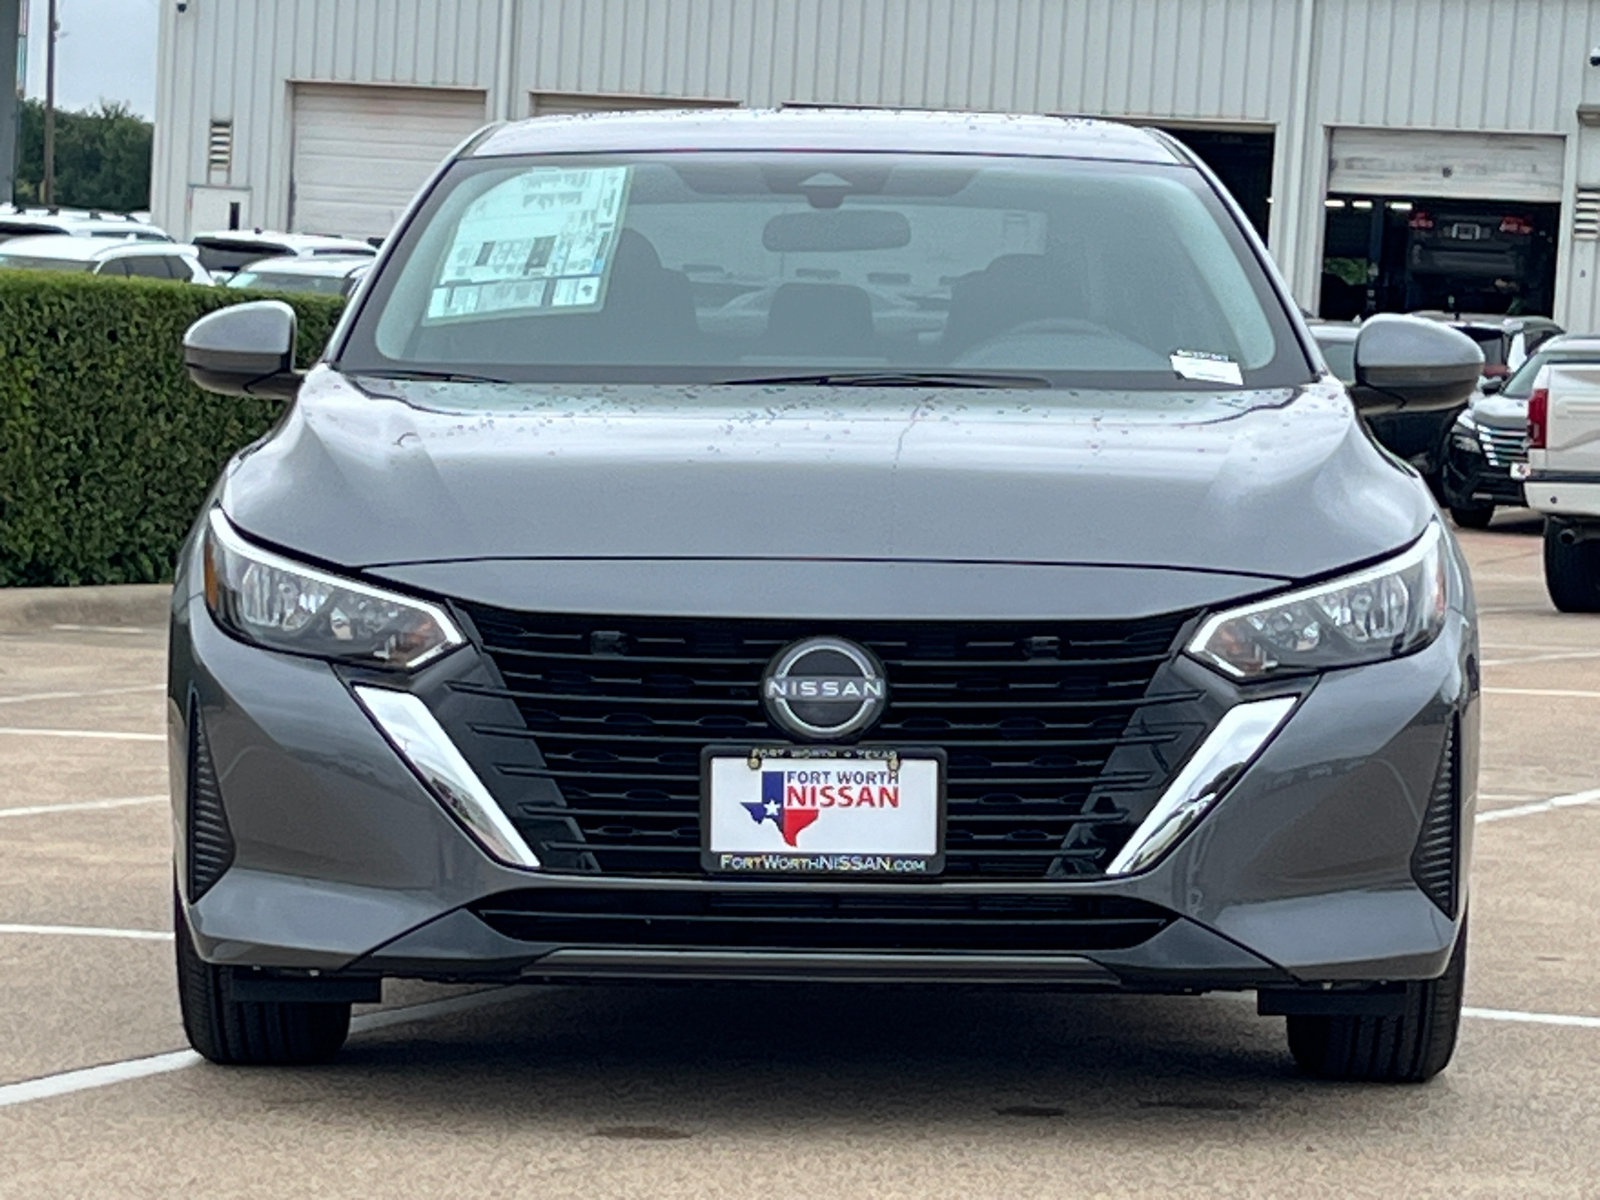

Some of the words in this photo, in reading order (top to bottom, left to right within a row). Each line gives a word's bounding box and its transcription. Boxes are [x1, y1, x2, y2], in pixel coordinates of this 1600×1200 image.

[768, 681, 882, 696] NISSAN
[786, 771, 831, 785] FORT
[836, 771, 900, 785] WORTH
[786, 785, 900, 808] NISSAN
